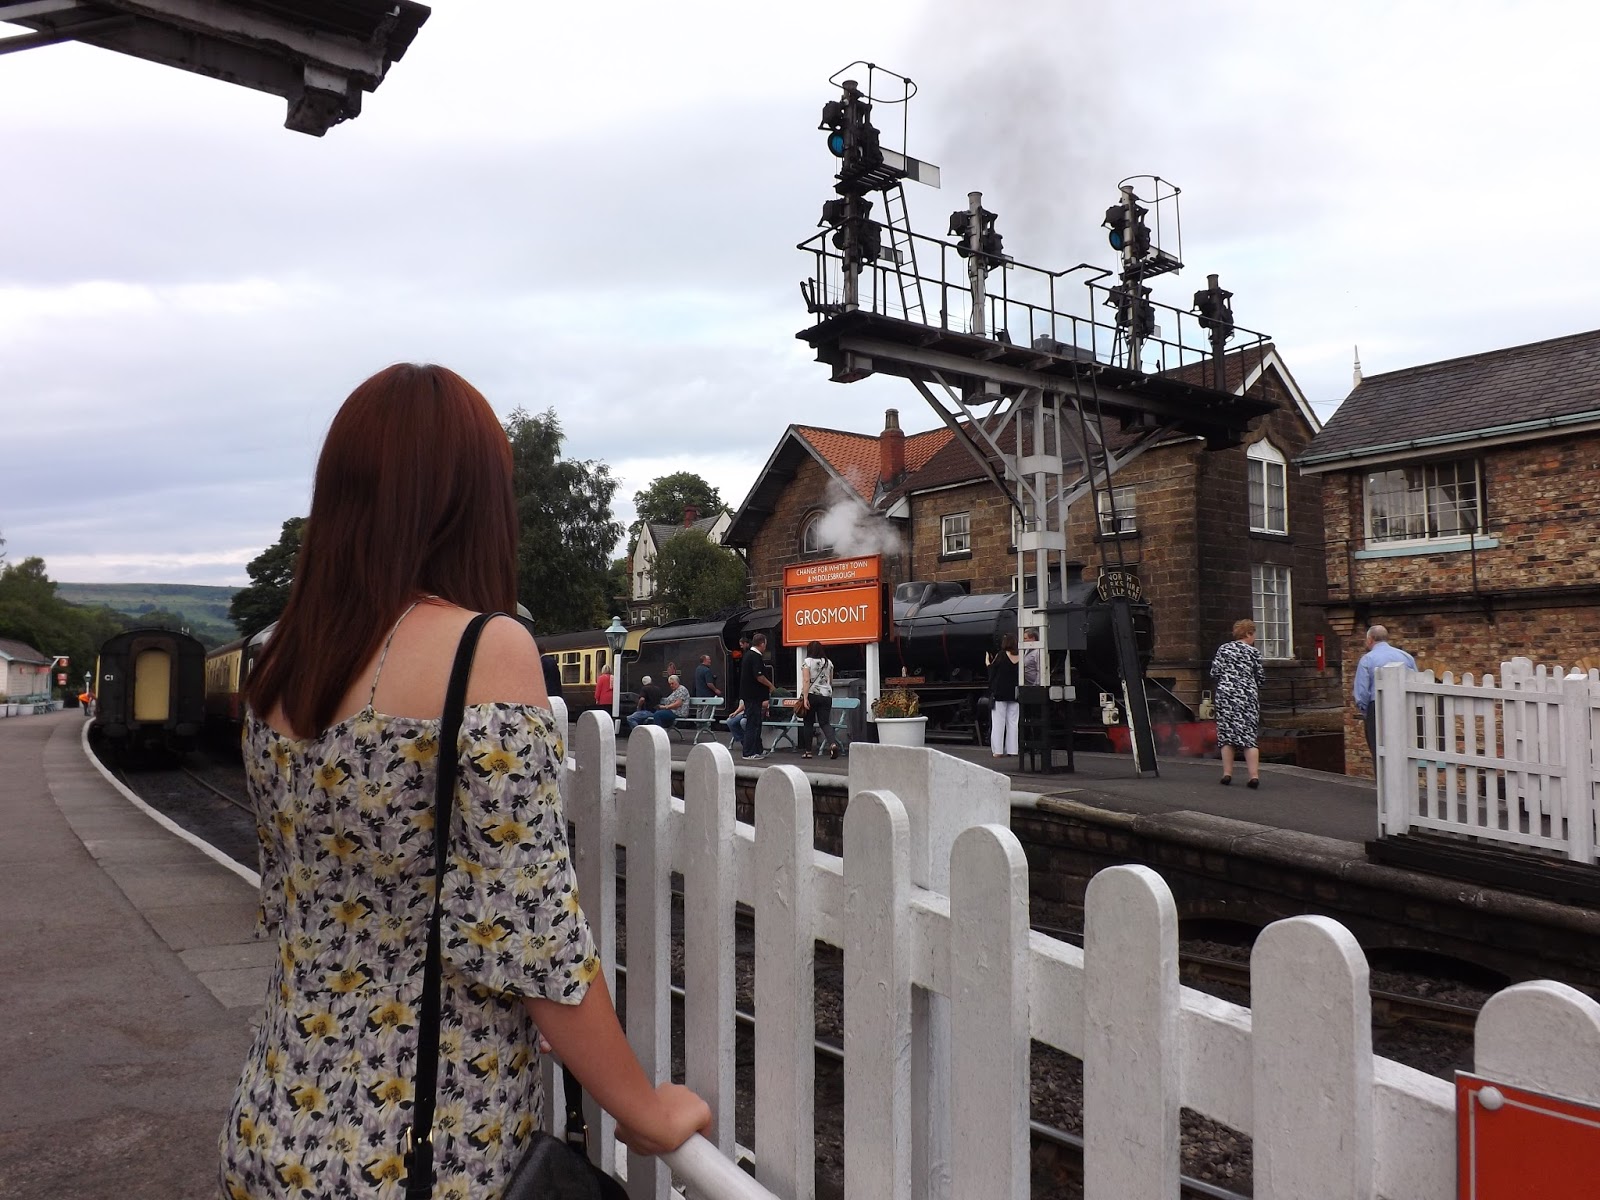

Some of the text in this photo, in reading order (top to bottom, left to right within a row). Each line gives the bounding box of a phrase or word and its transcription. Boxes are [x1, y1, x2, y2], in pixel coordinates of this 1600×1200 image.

[796, 561, 868, 576] CHANGE FOR WHITBY TOWN
[812, 571, 856, 582] MIDDLESBROUGH
[1108, 573, 1132, 582] NORH
[1100, 581, 1140, 593] YRKSIRE
[795, 604, 868, 626] GROSMONT
